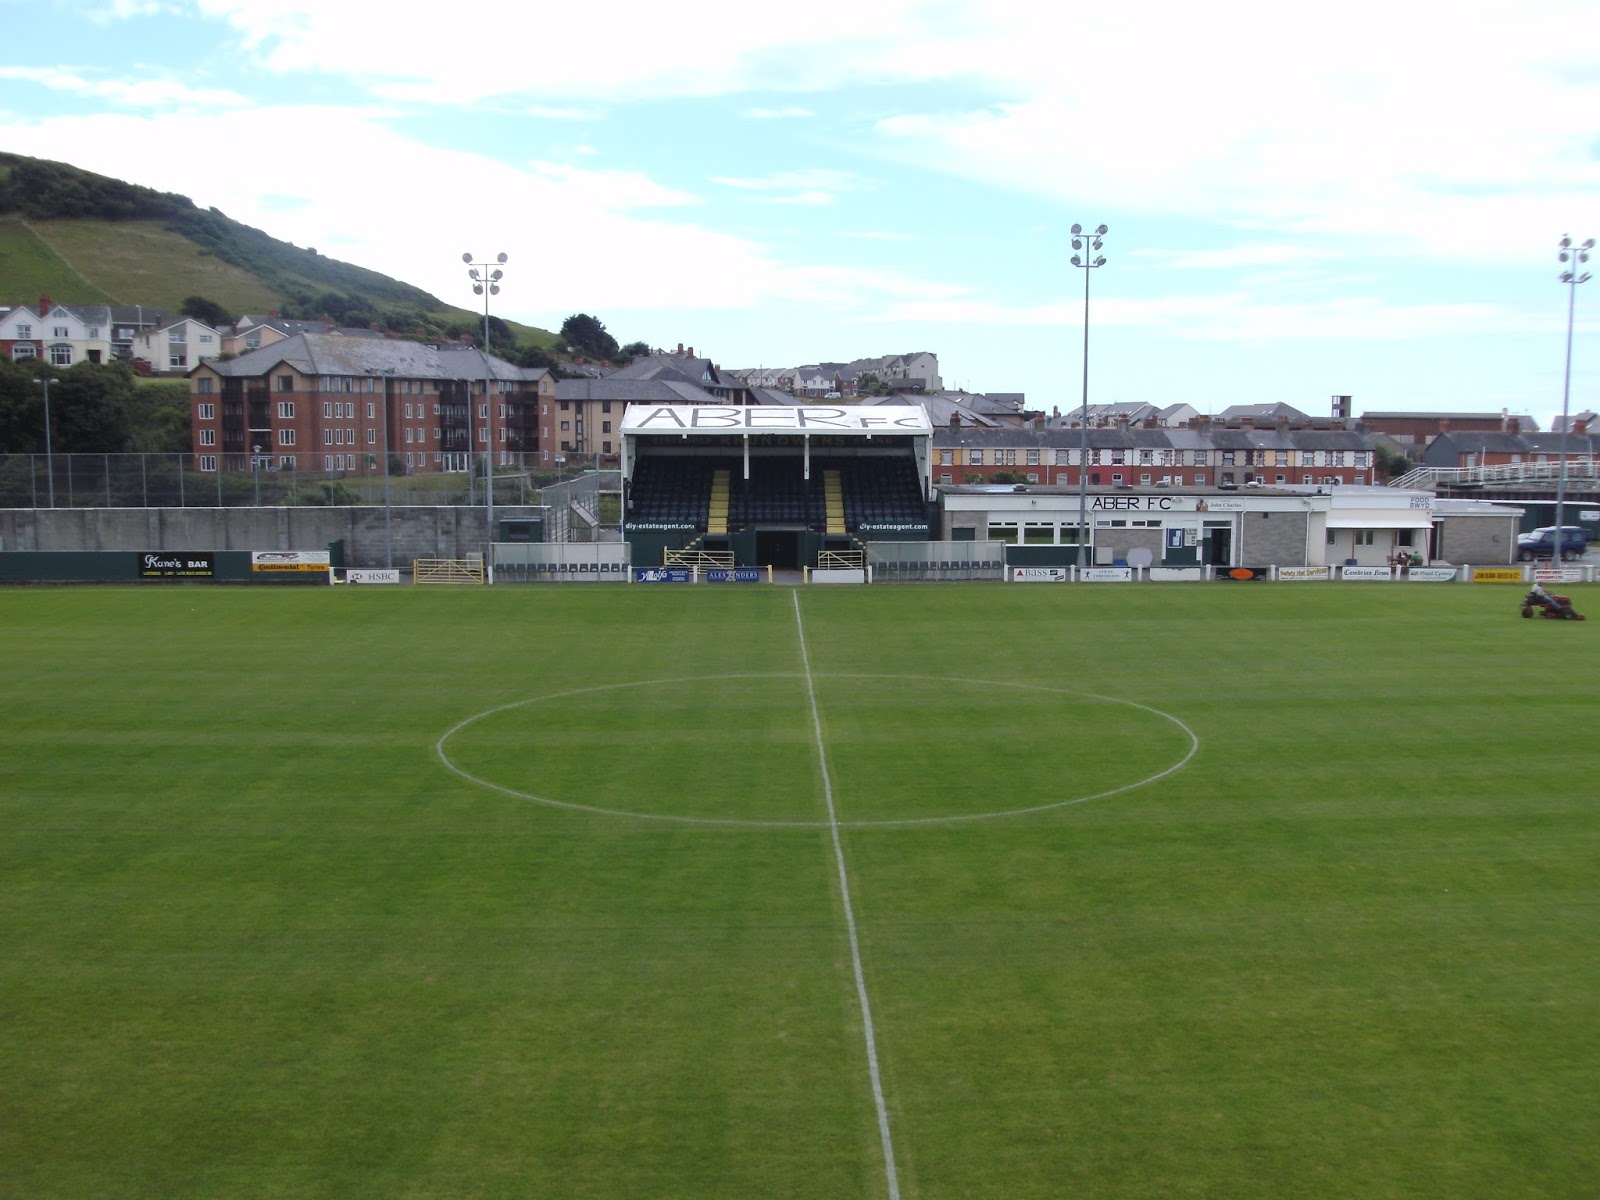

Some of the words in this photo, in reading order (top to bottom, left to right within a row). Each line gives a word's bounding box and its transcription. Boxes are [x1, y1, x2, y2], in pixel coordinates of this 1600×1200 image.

[637, 408, 850, 428] ABER
[861, 417, 921, 428] FC
[1092, 497, 1139, 510] ABER
[1148, 497, 1171, 510] FC
[625, 523, 695, 531] diy-estateagent.com
[859, 523, 928, 531] diy-estateagent.com
[144, 554, 182, 569] Kane's
[187, 560, 208, 568] BAR
[258, 563, 300, 571] Continental
[368, 572, 395, 580] HSBC
[1025, 569, 1048, 577] Bass
[1373, 568, 1390, 576] News
